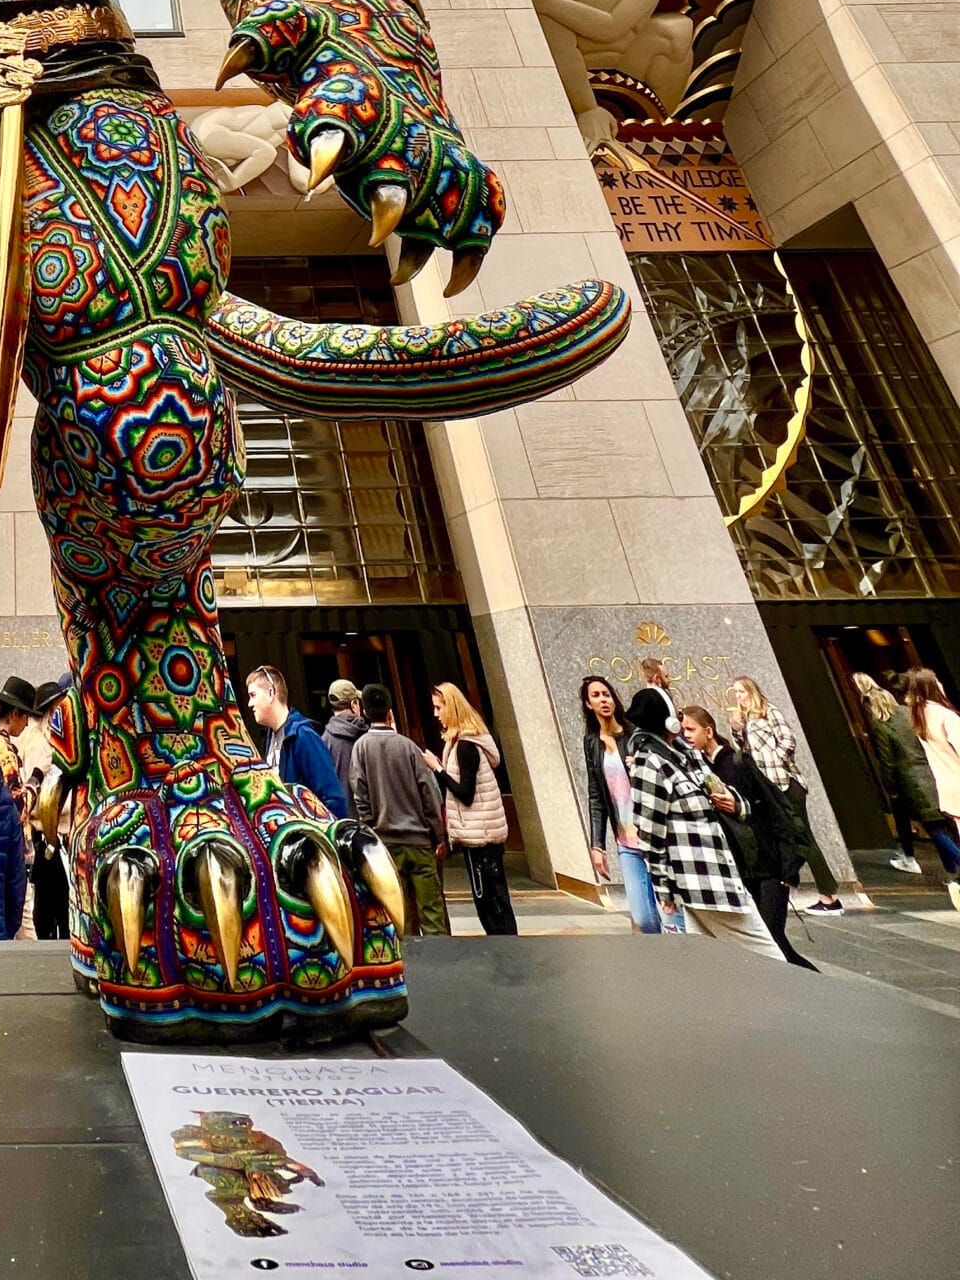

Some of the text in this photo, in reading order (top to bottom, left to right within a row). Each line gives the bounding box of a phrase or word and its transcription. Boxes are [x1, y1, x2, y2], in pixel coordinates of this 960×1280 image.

[619, 169, 745, 189] KNWLEDGE
[617, 195, 687, 215] BE THE
[638, 221, 682, 241] THY
[192, 1062, 390, 1076] MENCHACA
[172, 1085, 446, 1097] GUERRERO JAGUAR
[266, 1097, 366, 1108] (TIERRA)
